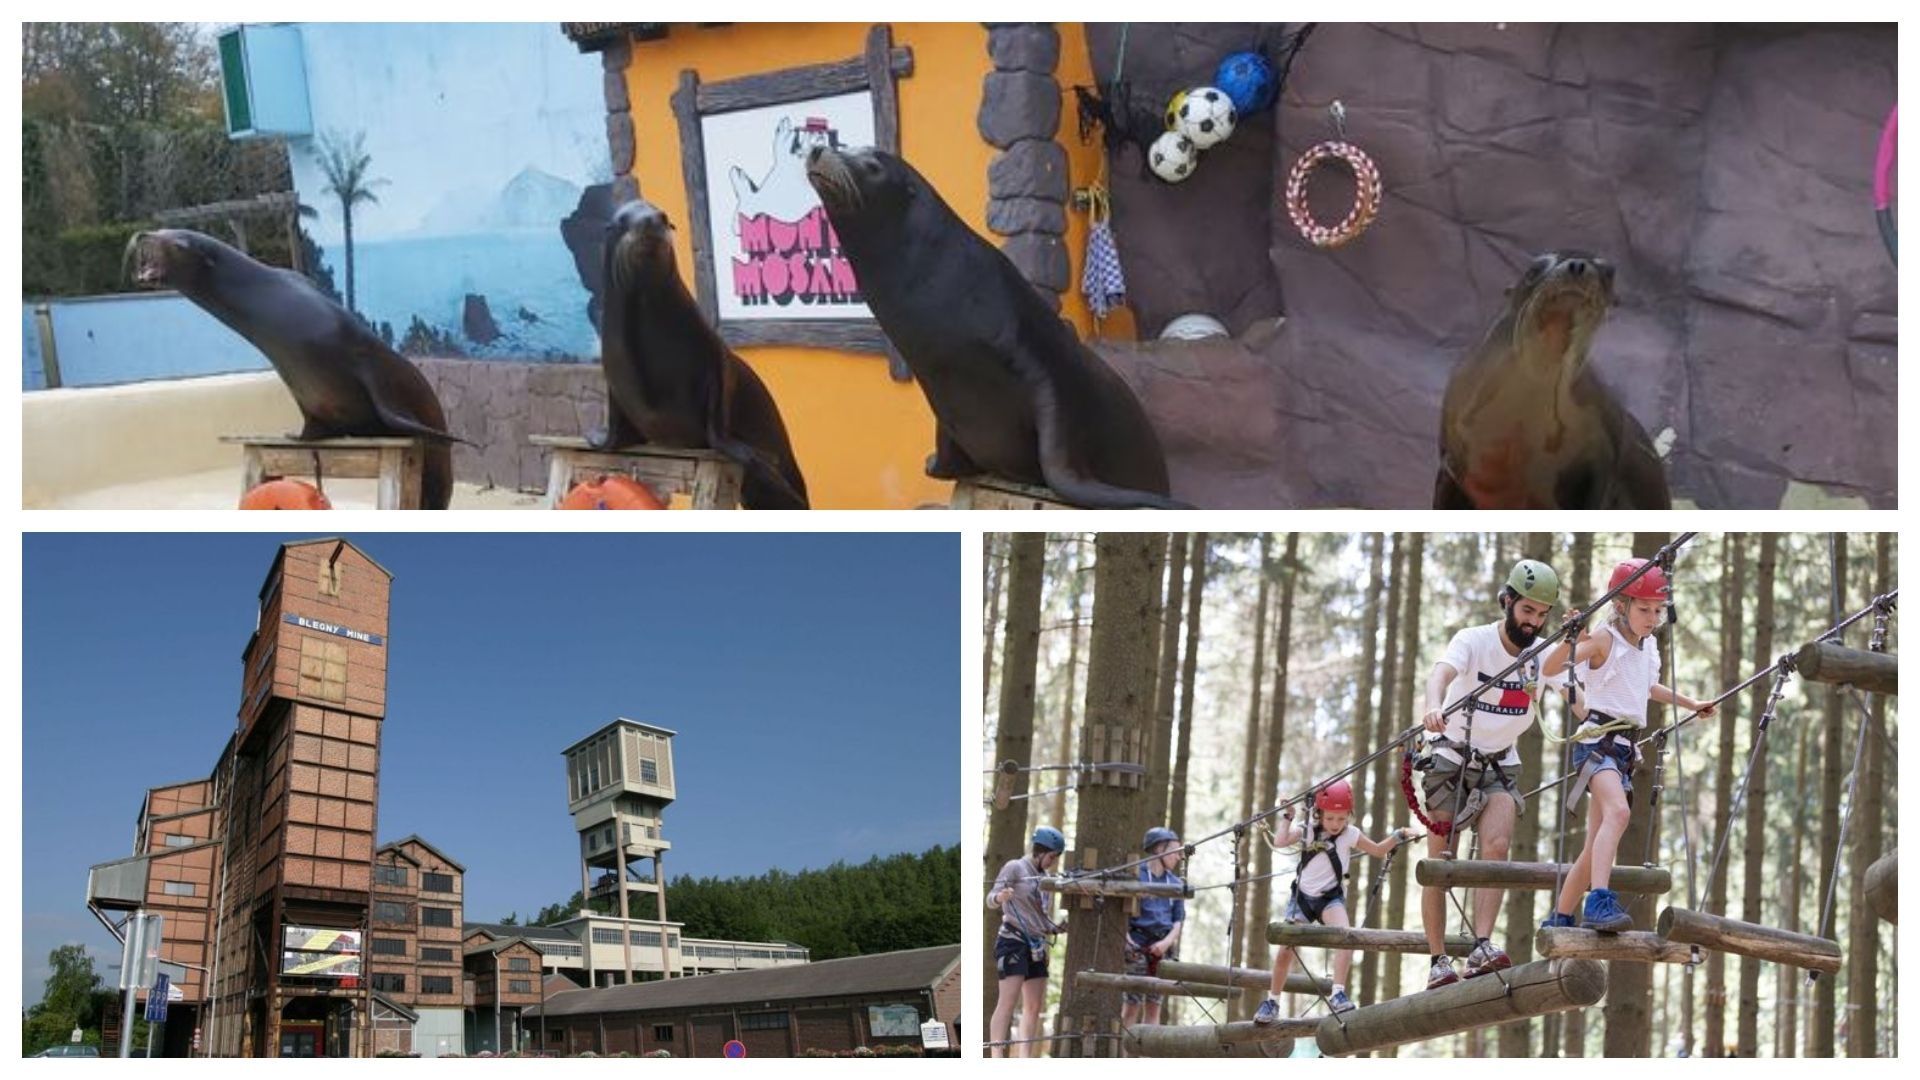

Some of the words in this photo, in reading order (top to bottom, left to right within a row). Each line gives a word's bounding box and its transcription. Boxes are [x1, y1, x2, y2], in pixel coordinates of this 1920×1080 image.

[298, 617, 340, 634] BLEGNY
[346, 629, 370, 642] MINE
[1494, 680, 1521, 689] ERTH
